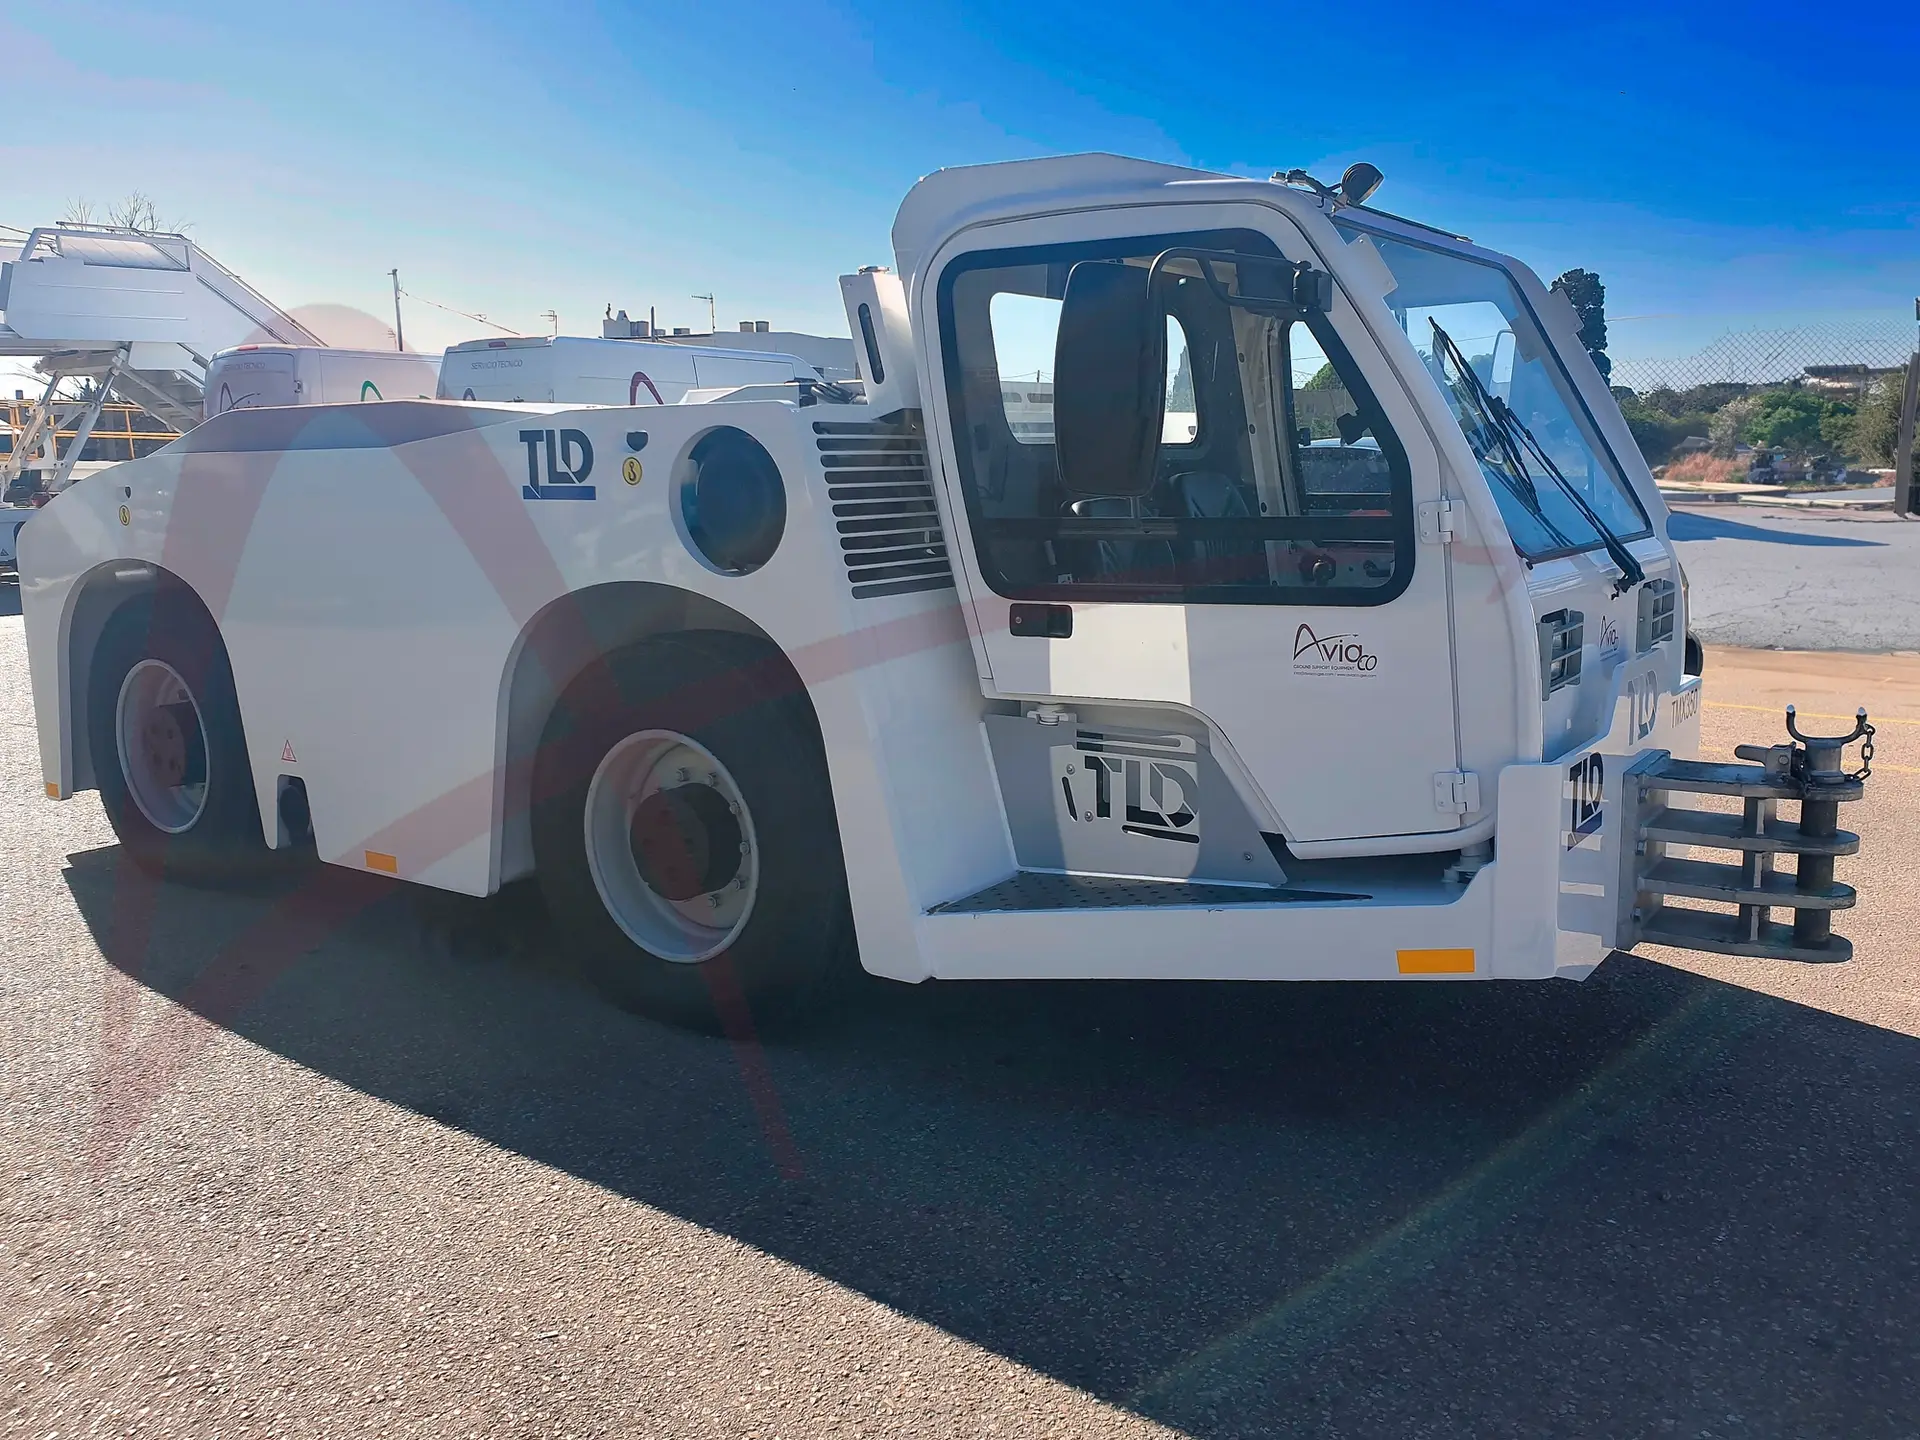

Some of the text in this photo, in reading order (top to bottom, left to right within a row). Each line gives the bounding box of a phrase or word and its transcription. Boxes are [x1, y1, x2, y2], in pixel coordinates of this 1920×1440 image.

[519, 428, 596, 500] TLD
[1627, 670, 1658, 747] TLD
[1084, 755, 1200, 829] TLD
[1569, 752, 1604, 852] TLD
